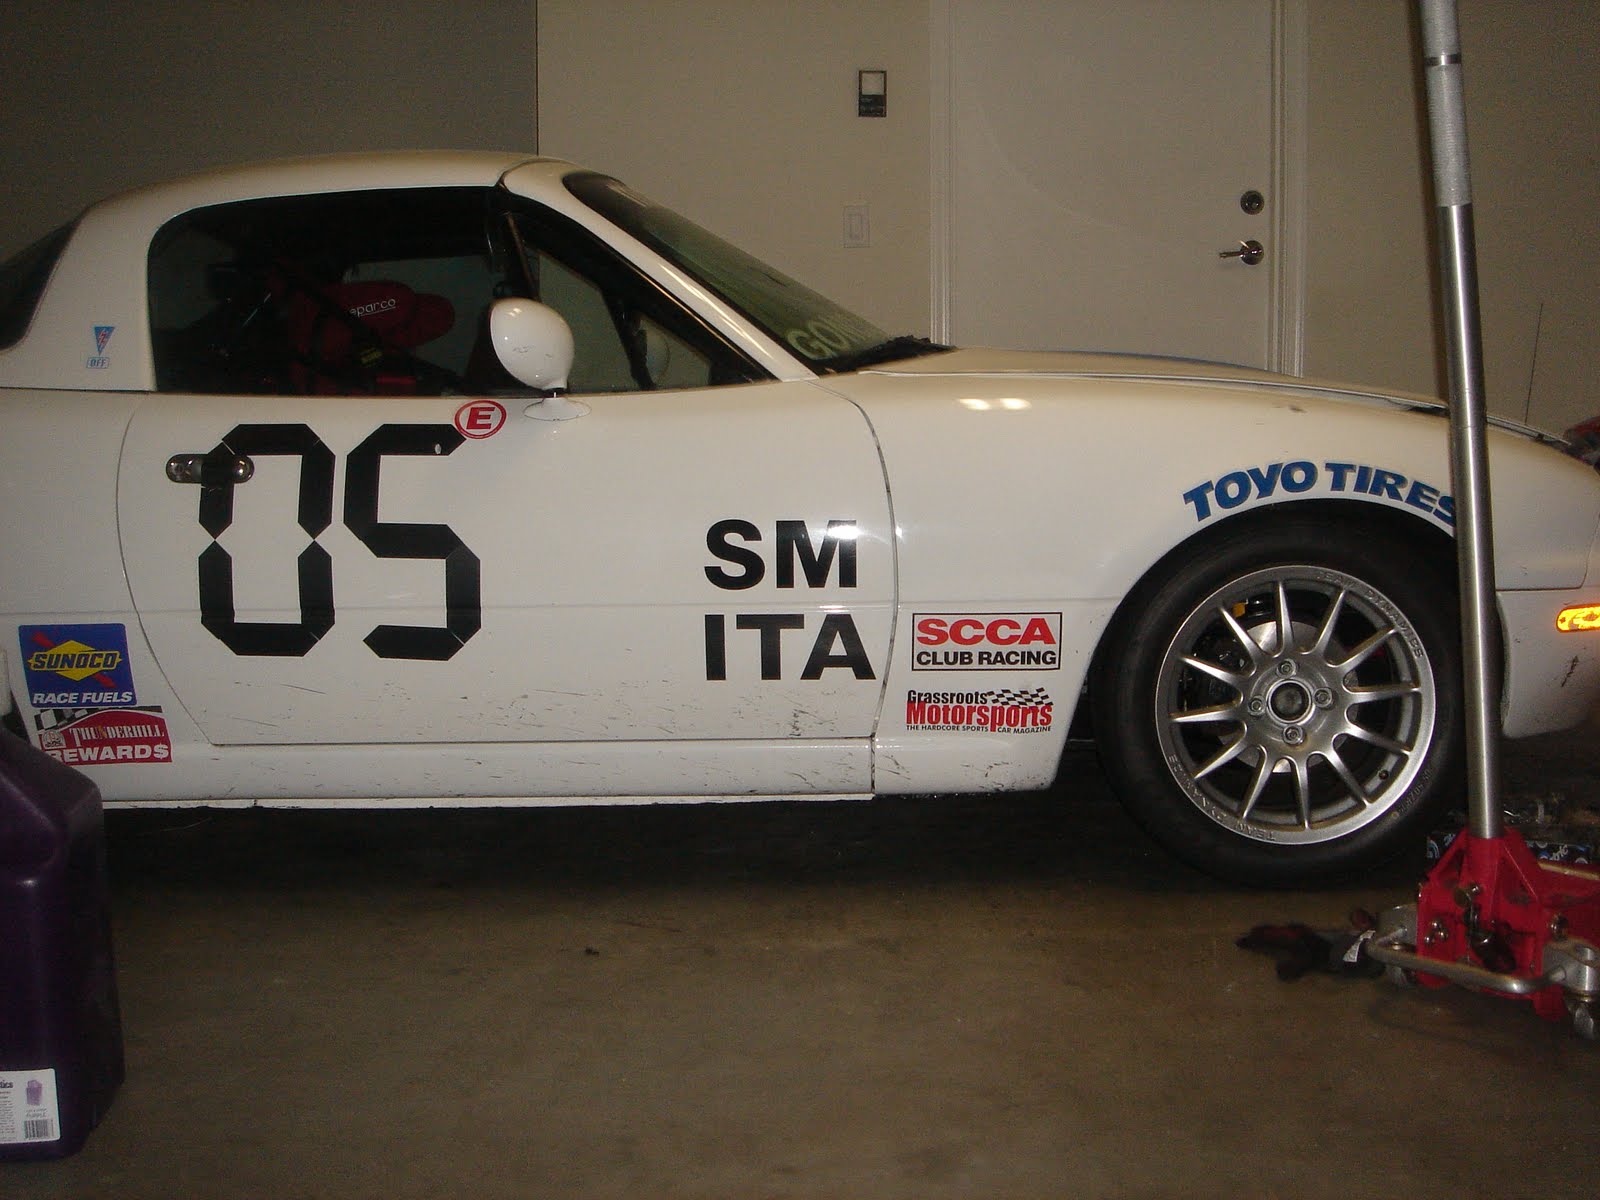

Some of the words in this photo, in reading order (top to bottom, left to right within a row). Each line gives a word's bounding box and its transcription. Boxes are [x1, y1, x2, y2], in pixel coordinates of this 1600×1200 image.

[466, 407, 495, 430] E
[1183, 461, 1318, 522] TOYO
[1325, 462, 1457, 528] TIRES
[704, 519, 857, 590] SM
[916, 618, 1056, 645] SCCA
[704, 614, 876, 680] ITA
[916, 651, 973, 665] CLUB
[978, 651, 1056, 665] RACING
[33, 653, 117, 668] SUNOCO
[33, 693, 78, 703] RACE
[82, 692, 133, 703] FUELS
[908, 690, 988, 704] Grassroots
[906, 701, 1053, 732] Motorsports
[69, 724, 165, 747] THUNDERHILL
[1013, 726, 1051, 734] MAGAZINE
